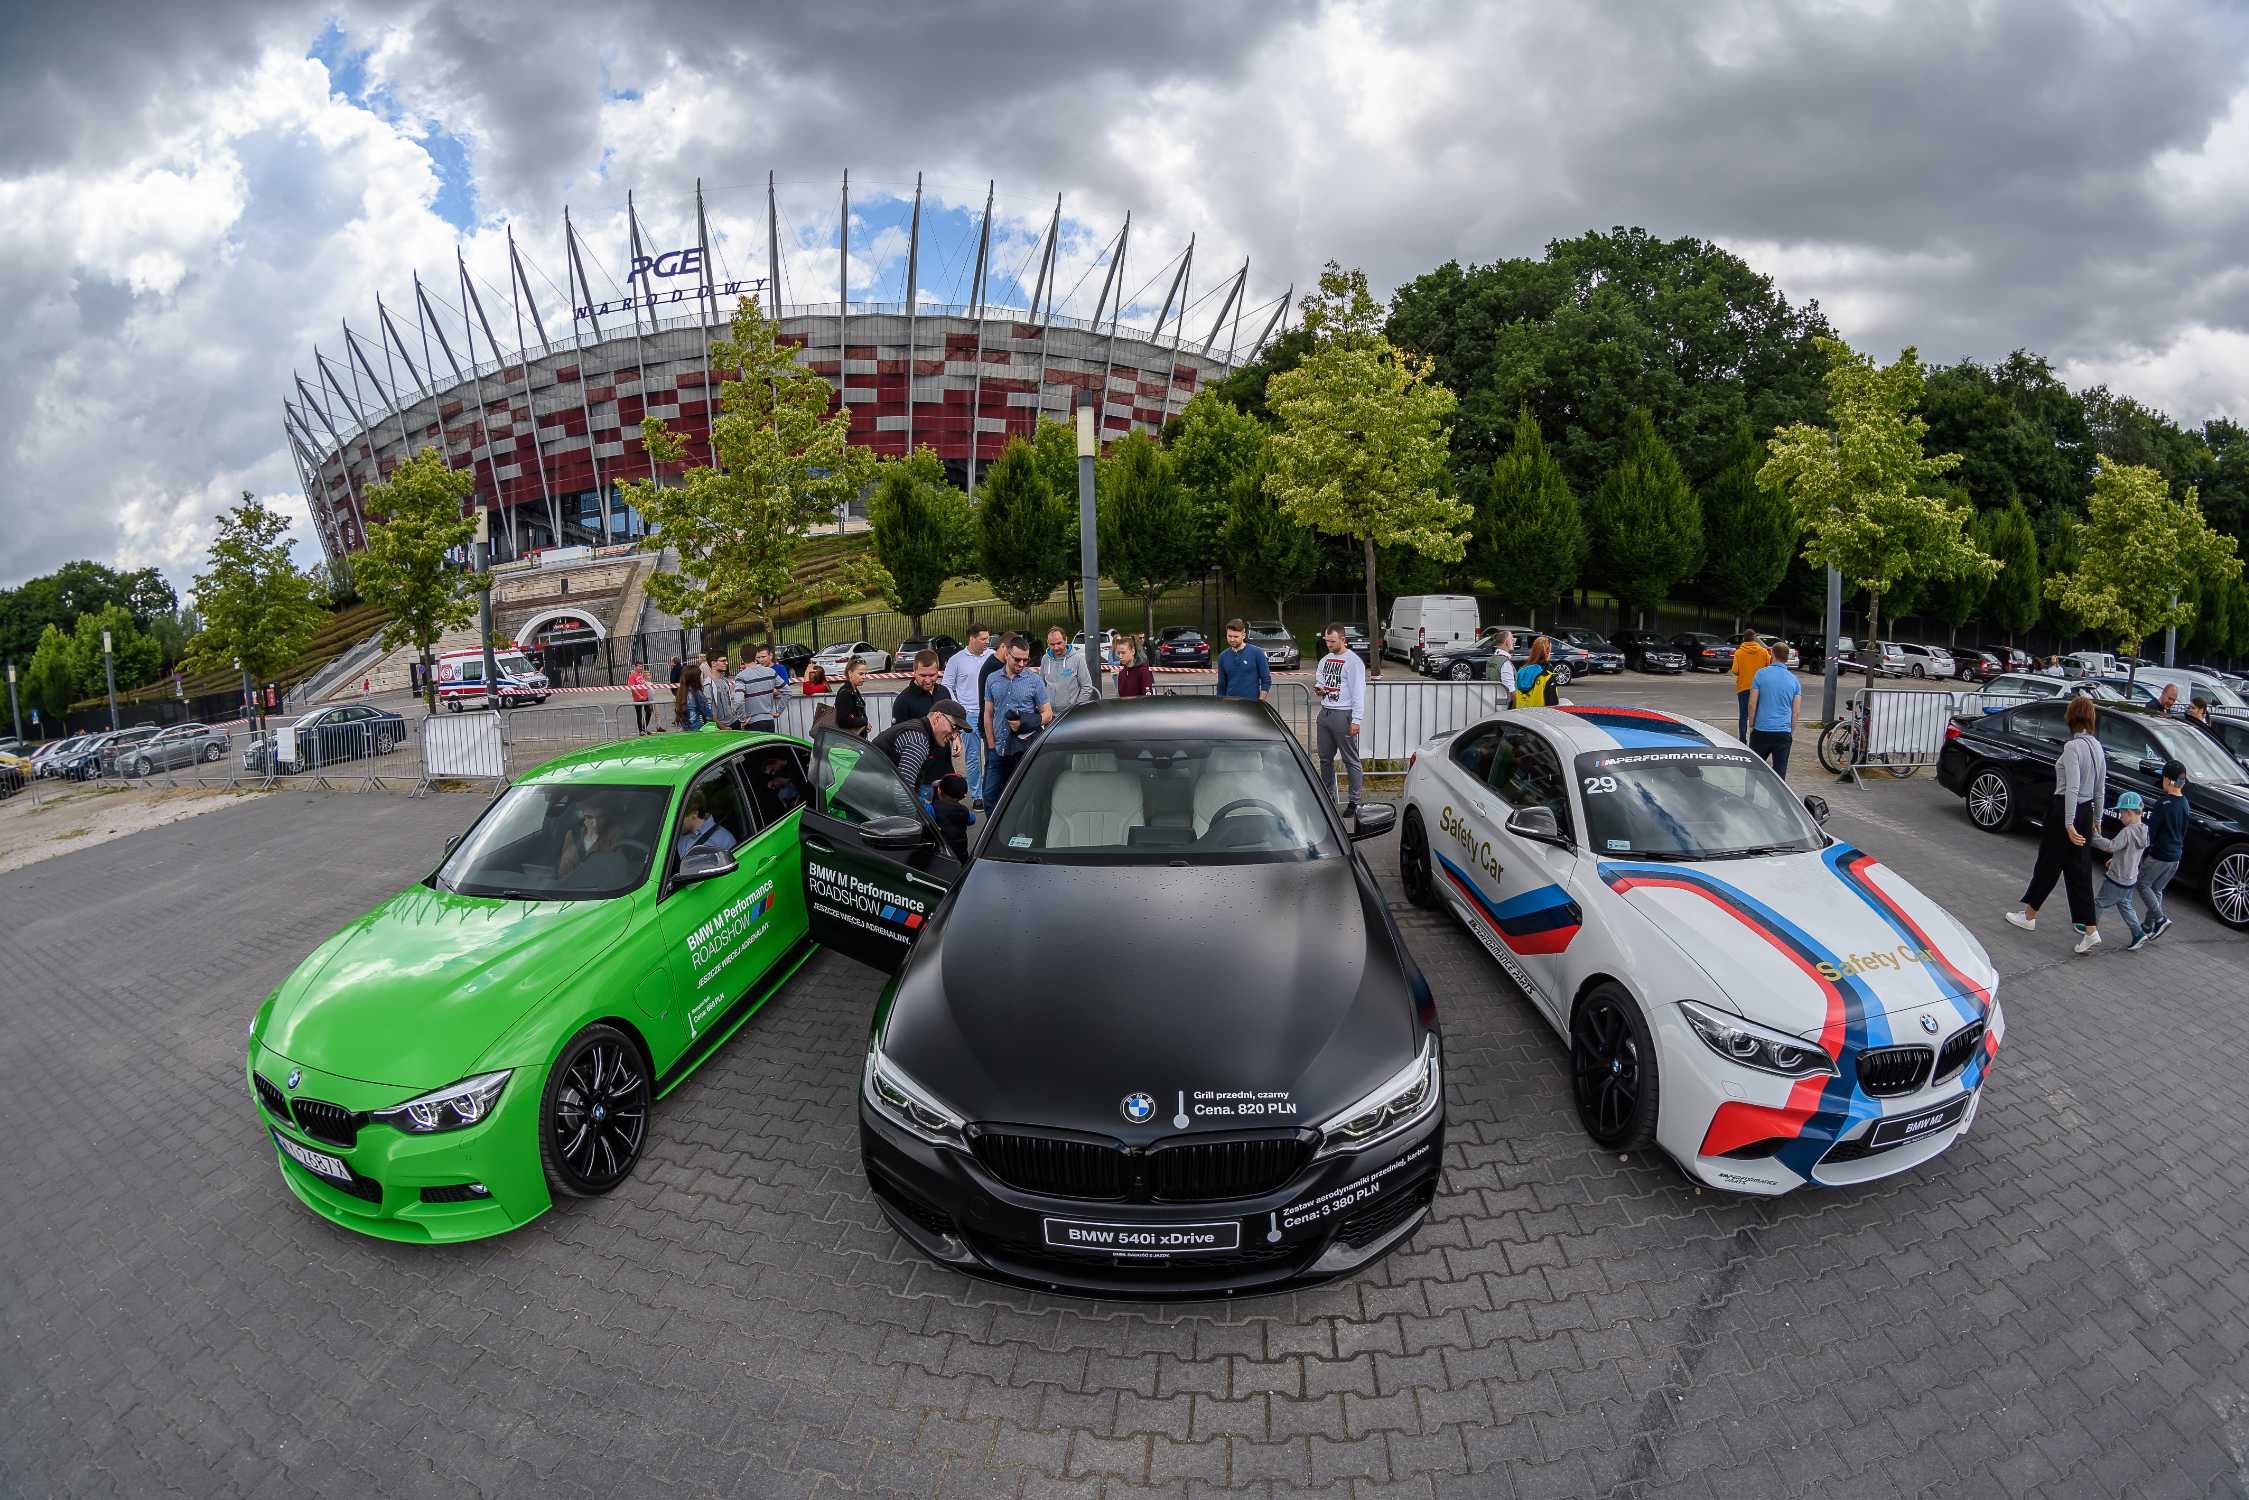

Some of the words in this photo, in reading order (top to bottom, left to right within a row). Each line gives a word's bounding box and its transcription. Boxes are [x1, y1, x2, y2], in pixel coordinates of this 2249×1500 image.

[627, 247, 704, 284] PGE
[1584, 776, 1618, 794] 29
[1440, 806, 1478, 864] Safety
[1481, 841, 1504, 884] Car
[809, 861, 836, 883] BMW
[838, 871, 848, 888] M
[850, 876, 925, 913] Performance
[809, 878, 881, 916] ROADSHOW
[687, 922, 714, 952] BMW
[713, 914, 724, 931] M
[723, 880, 774, 923] Performance
[691, 910, 751, 971] ROADSHOW
[1816, 951, 1901, 982] Safety
[1193, 1091, 1214, 1099] Grill
[1216, 1091, 1256, 1101] przedni,
[1257, 1091, 1289, 1100] czarny
[1238, 1103, 1265, 1114] 820
[1268, 1103, 1297, 1114] PLN
[1905, 1117, 1931, 1134] BMW
[1929, 1113, 1944, 1126] M2
[1284, 1210, 1320, 1228] Cena:
[1322, 1204, 1331, 1216] 3
[1332, 1195, 1354, 1212] 380
[1356, 1182, 1381, 1201] PLN
[1315, 1175, 1370, 1205] aerodynamiki
[1068, 1229, 1114, 1243] BMW
[1118, 1232, 1155, 1244] 540i
[1160, 1232, 1215, 1245] xDrive
